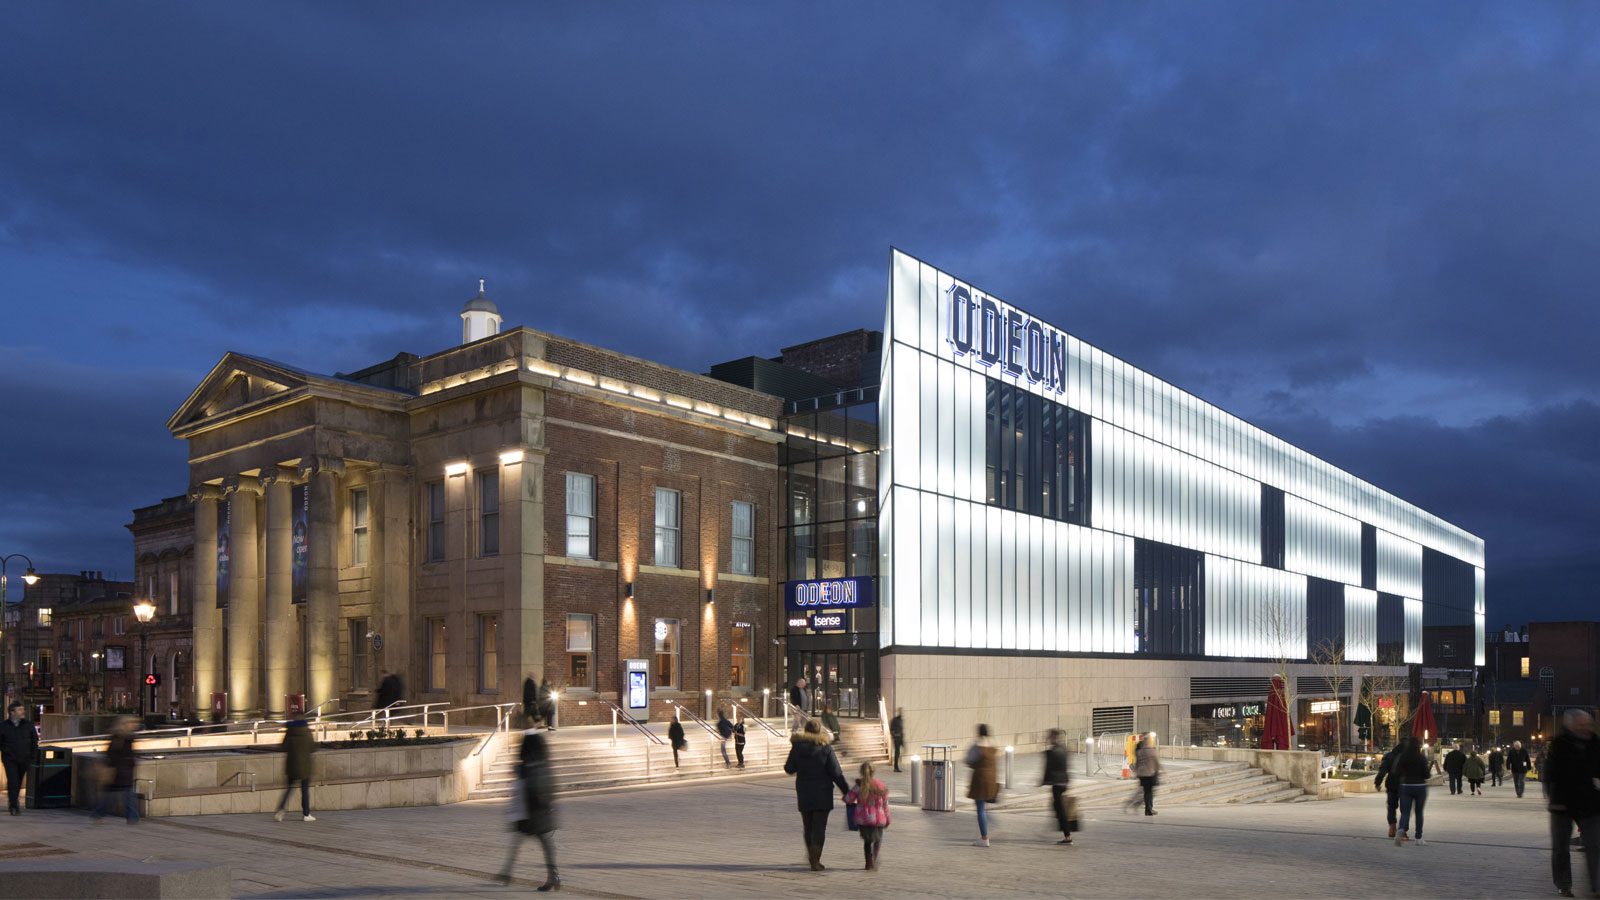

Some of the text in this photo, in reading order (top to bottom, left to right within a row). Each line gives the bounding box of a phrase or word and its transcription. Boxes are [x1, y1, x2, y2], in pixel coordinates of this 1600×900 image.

[946, 283, 1066, 395] ODEON
[796, 580, 856, 606] ODEON
[814, 616, 841, 626] isense
